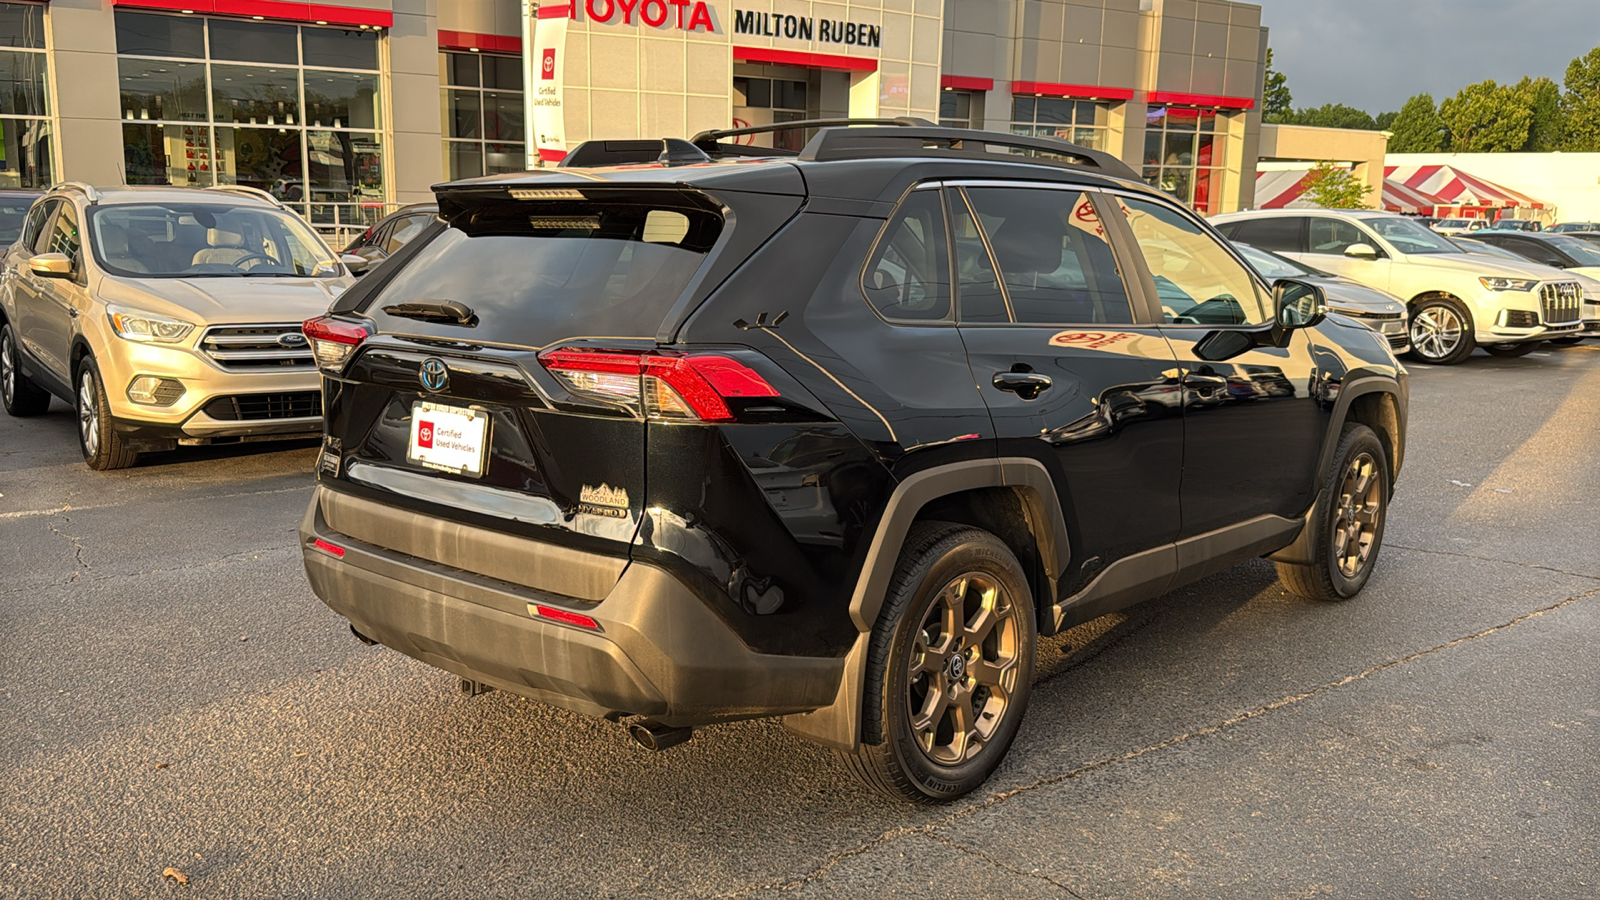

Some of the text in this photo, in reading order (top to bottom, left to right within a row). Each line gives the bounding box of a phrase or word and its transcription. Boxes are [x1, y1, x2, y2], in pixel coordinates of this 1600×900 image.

[734, 9, 881, 47] MILTON RUBEN
[437, 427, 462, 439] Certified
[436, 438, 475, 453] Used Vehicles
[582, 494, 626, 505] WOODLAND
[974, 547, 1013, 569] MICHELIN
[925, 777, 962, 793] ICHELIN
